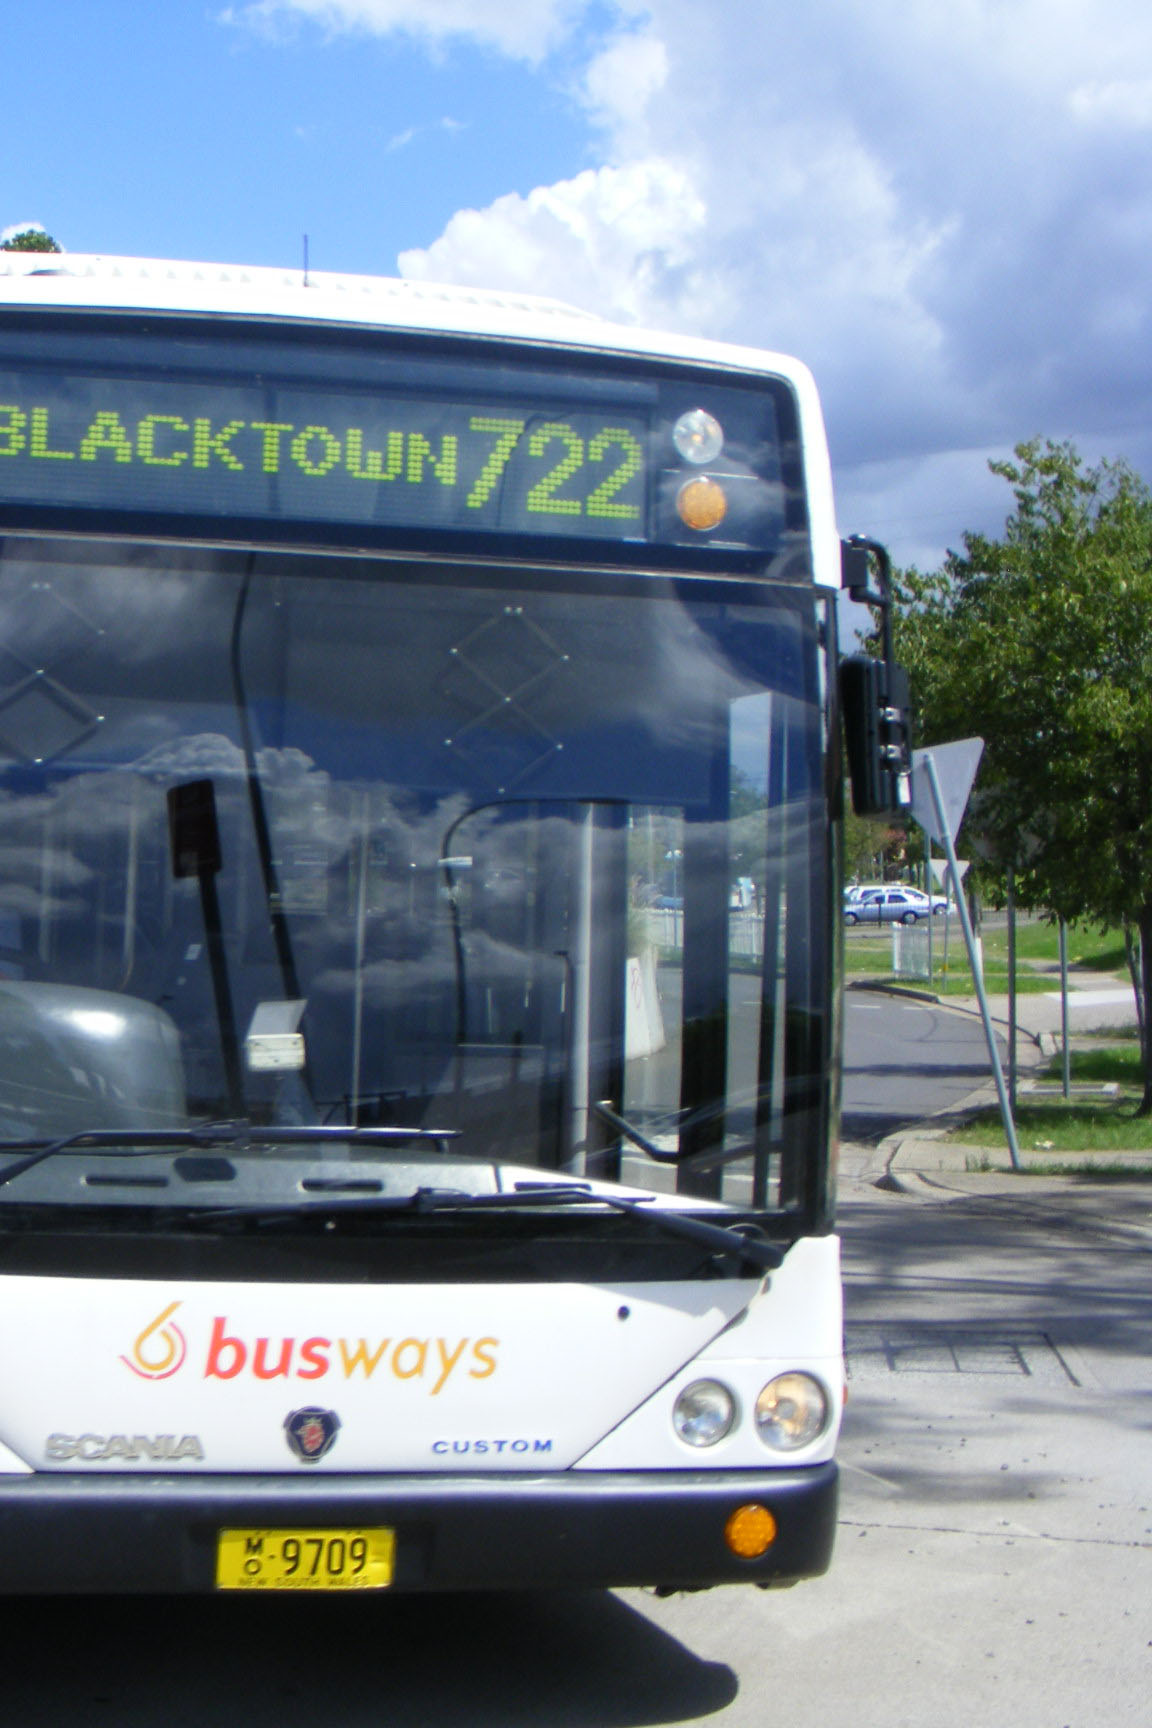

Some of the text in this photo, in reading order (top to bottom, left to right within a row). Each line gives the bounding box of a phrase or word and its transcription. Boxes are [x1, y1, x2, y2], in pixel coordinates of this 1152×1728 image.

[466, 416, 644, 519] 722
[203, 1316, 500, 1396] busways
[45, 1432, 205, 1461] SCANIA
[431, 1439, 553, 1454] CUSTOM
[282, 1537, 367, 1576] 9709
